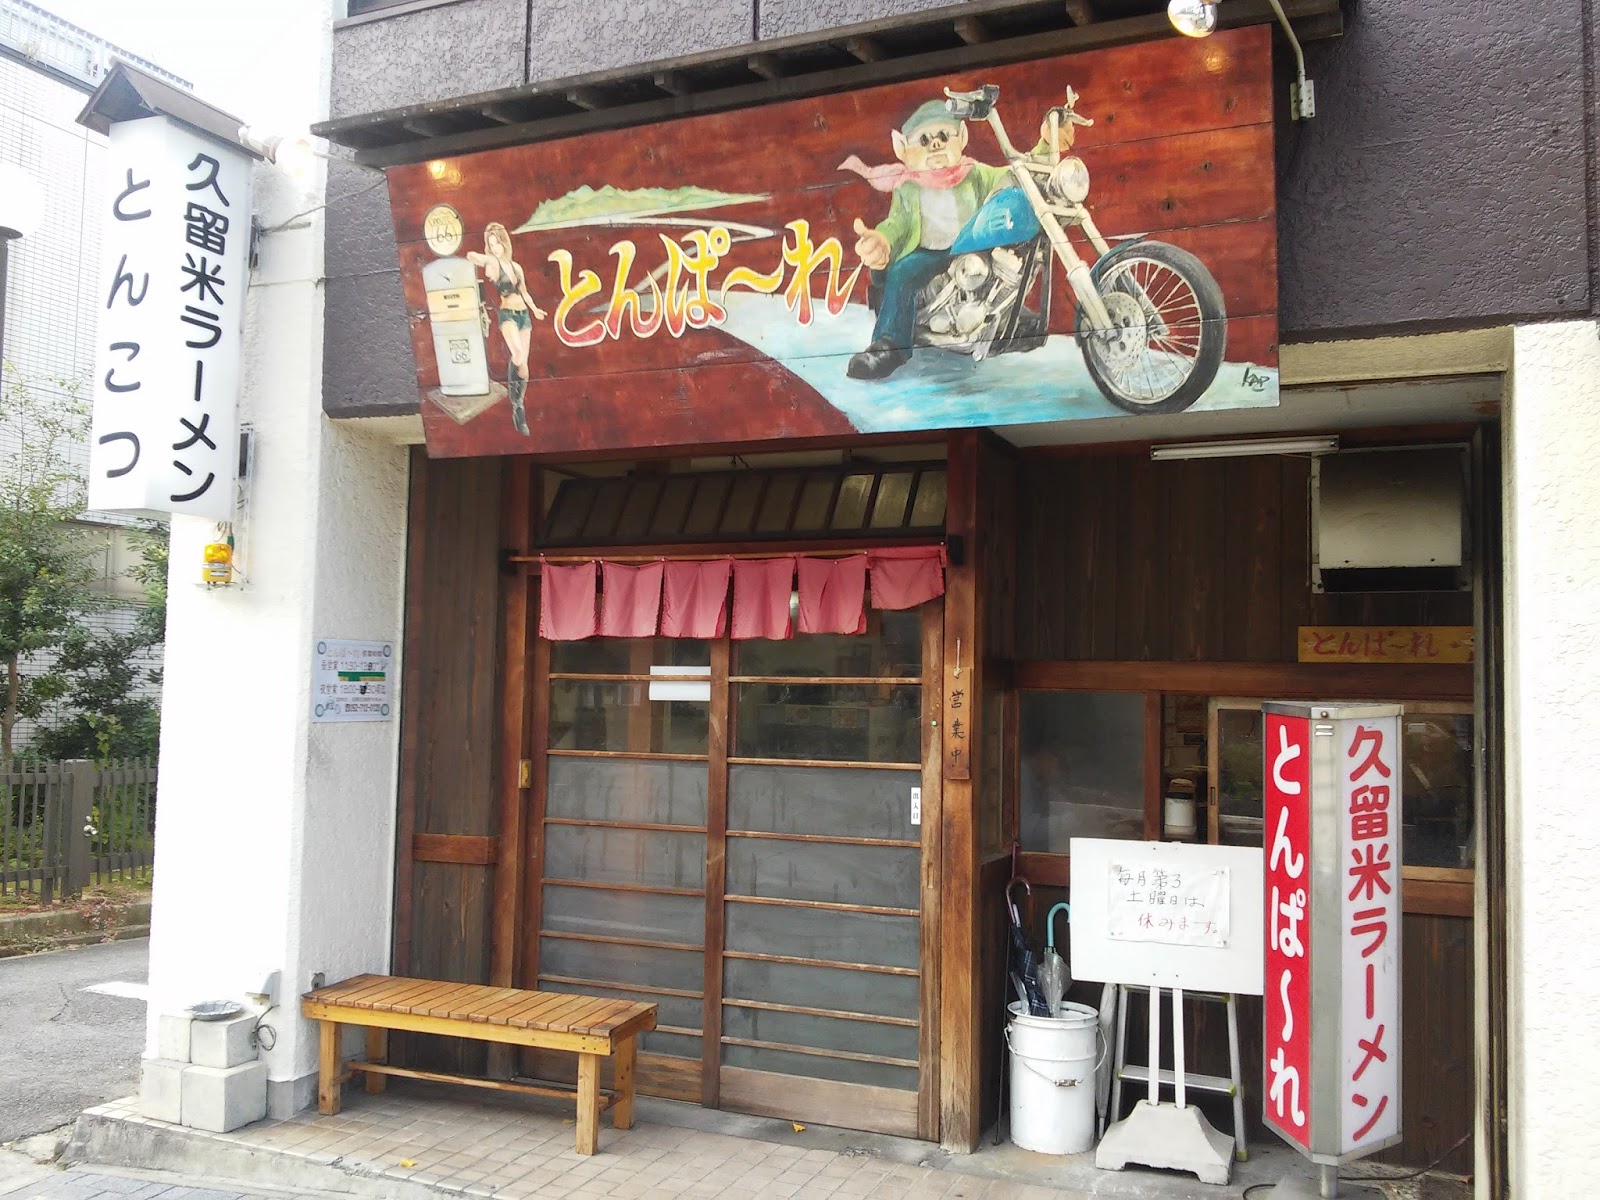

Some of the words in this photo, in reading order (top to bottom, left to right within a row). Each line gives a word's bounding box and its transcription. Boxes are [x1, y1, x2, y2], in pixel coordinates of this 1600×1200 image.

[99, 168, 152, 478] とんこつ
[170, 152, 229, 502] 久留米ラーメン
[912, 792, 920, 820] 出入口
[949, 689, 965, 763] 営業中
[1127, 891, 1205, 908] 土曜日は
[1347, 725, 1391, 1142] 久留米ラーメン
